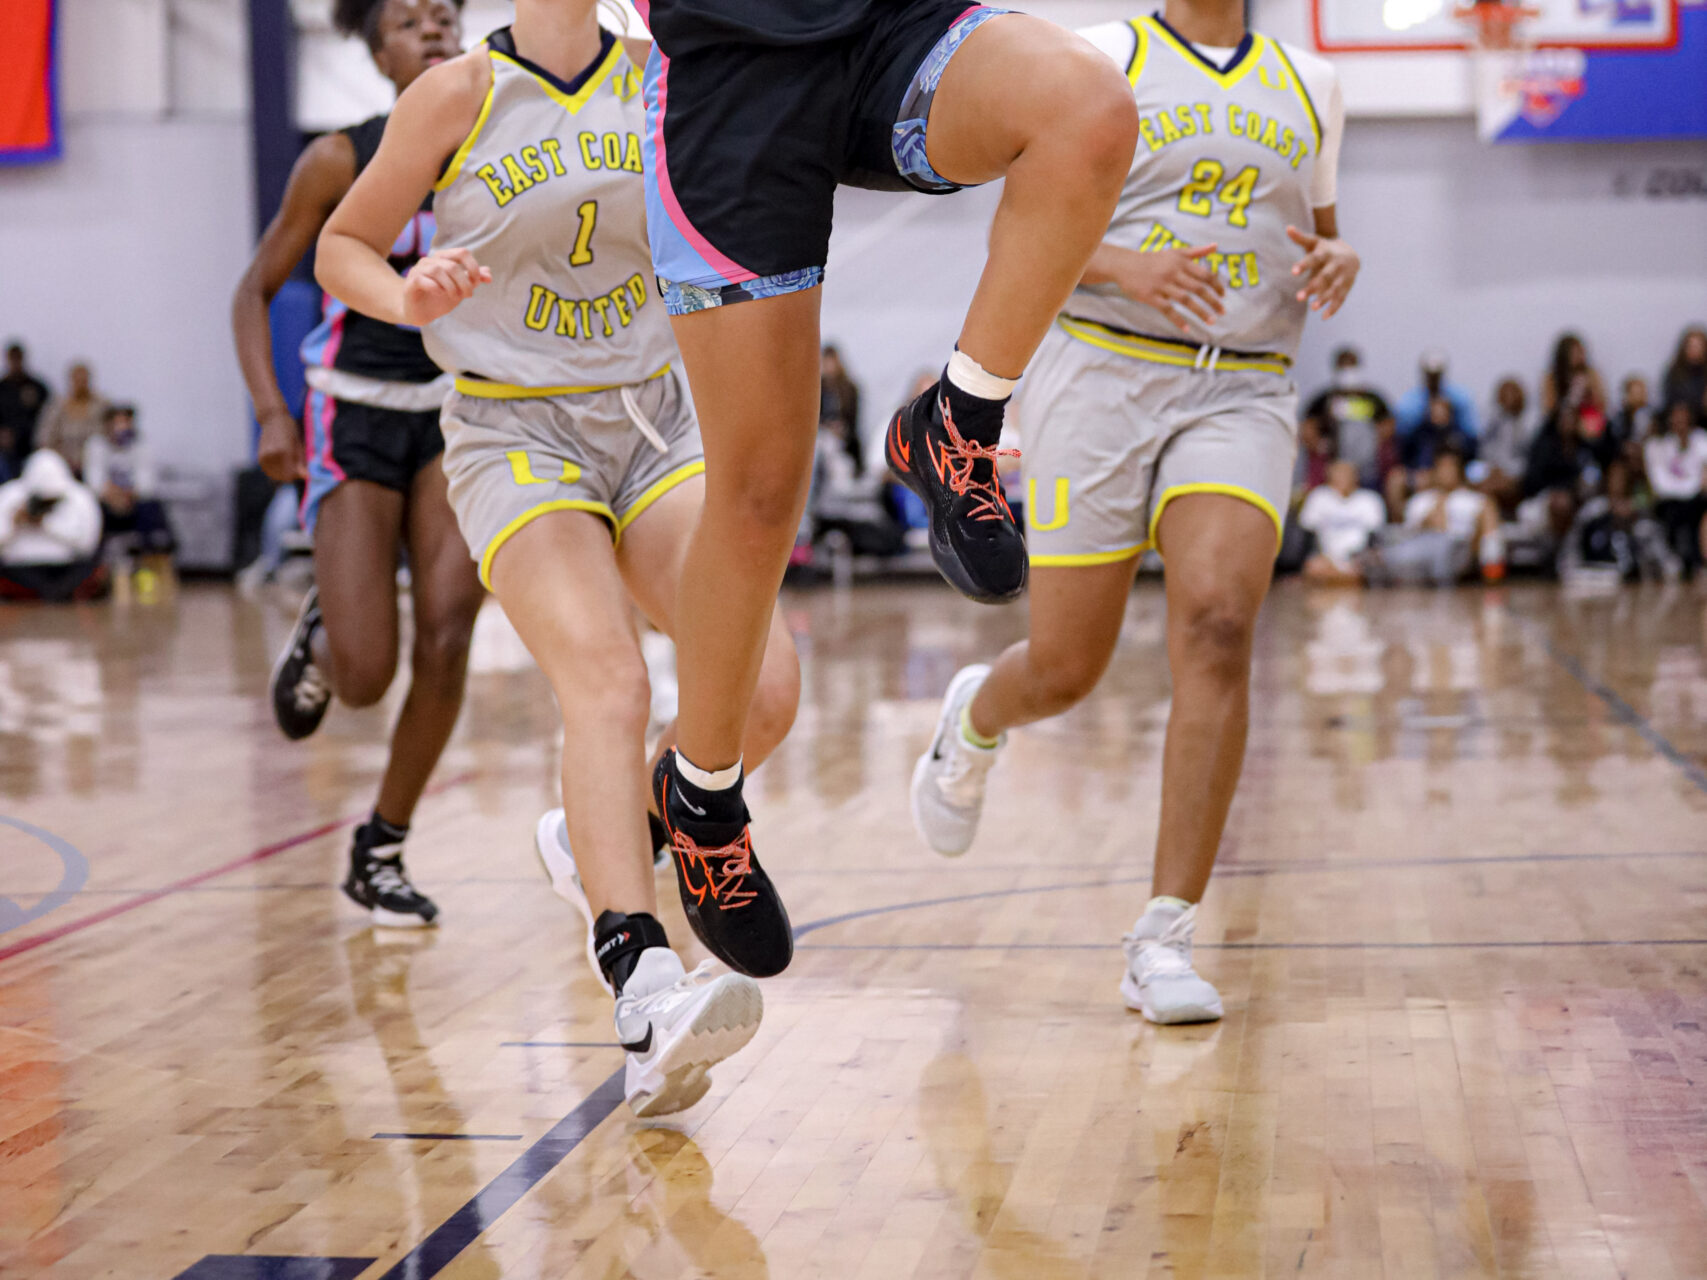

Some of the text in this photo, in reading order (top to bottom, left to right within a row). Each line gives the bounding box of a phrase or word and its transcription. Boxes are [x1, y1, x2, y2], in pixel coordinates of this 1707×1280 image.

[476, 130, 644, 208] EAST COA
[1139, 103, 1309, 170] EAST COAST
[1177, 158, 1260, 229] 24
[568, 199, 598, 268] 1
[1138, 221, 1260, 290] UTED
[523, 272, 648, 340] UNITED
[1029, 476, 1070, 532] U
